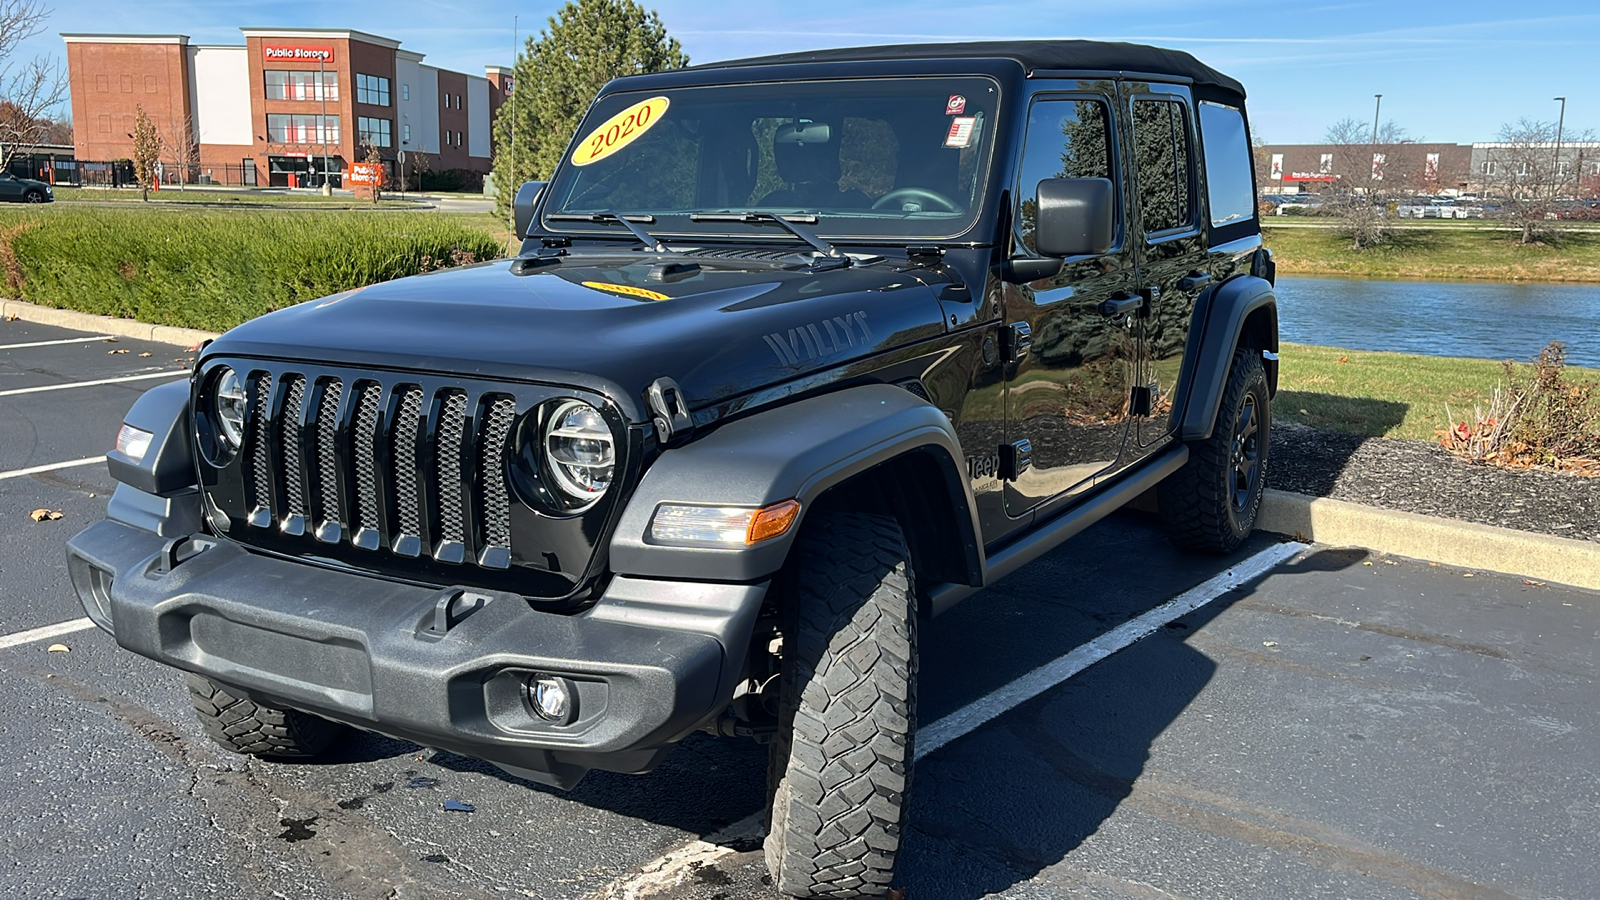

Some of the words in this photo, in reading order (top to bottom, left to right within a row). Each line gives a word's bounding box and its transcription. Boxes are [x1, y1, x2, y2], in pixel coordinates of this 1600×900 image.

[266, 48, 293, 57] Public
[295, 48, 329, 60] Storage
[590, 105, 651, 158] 2020
[353, 165, 376, 174] Pub
[762, 310, 874, 367] WILLYS
[968, 454, 1000, 480] Jeep
[972, 479, 998, 493] ANGLER
